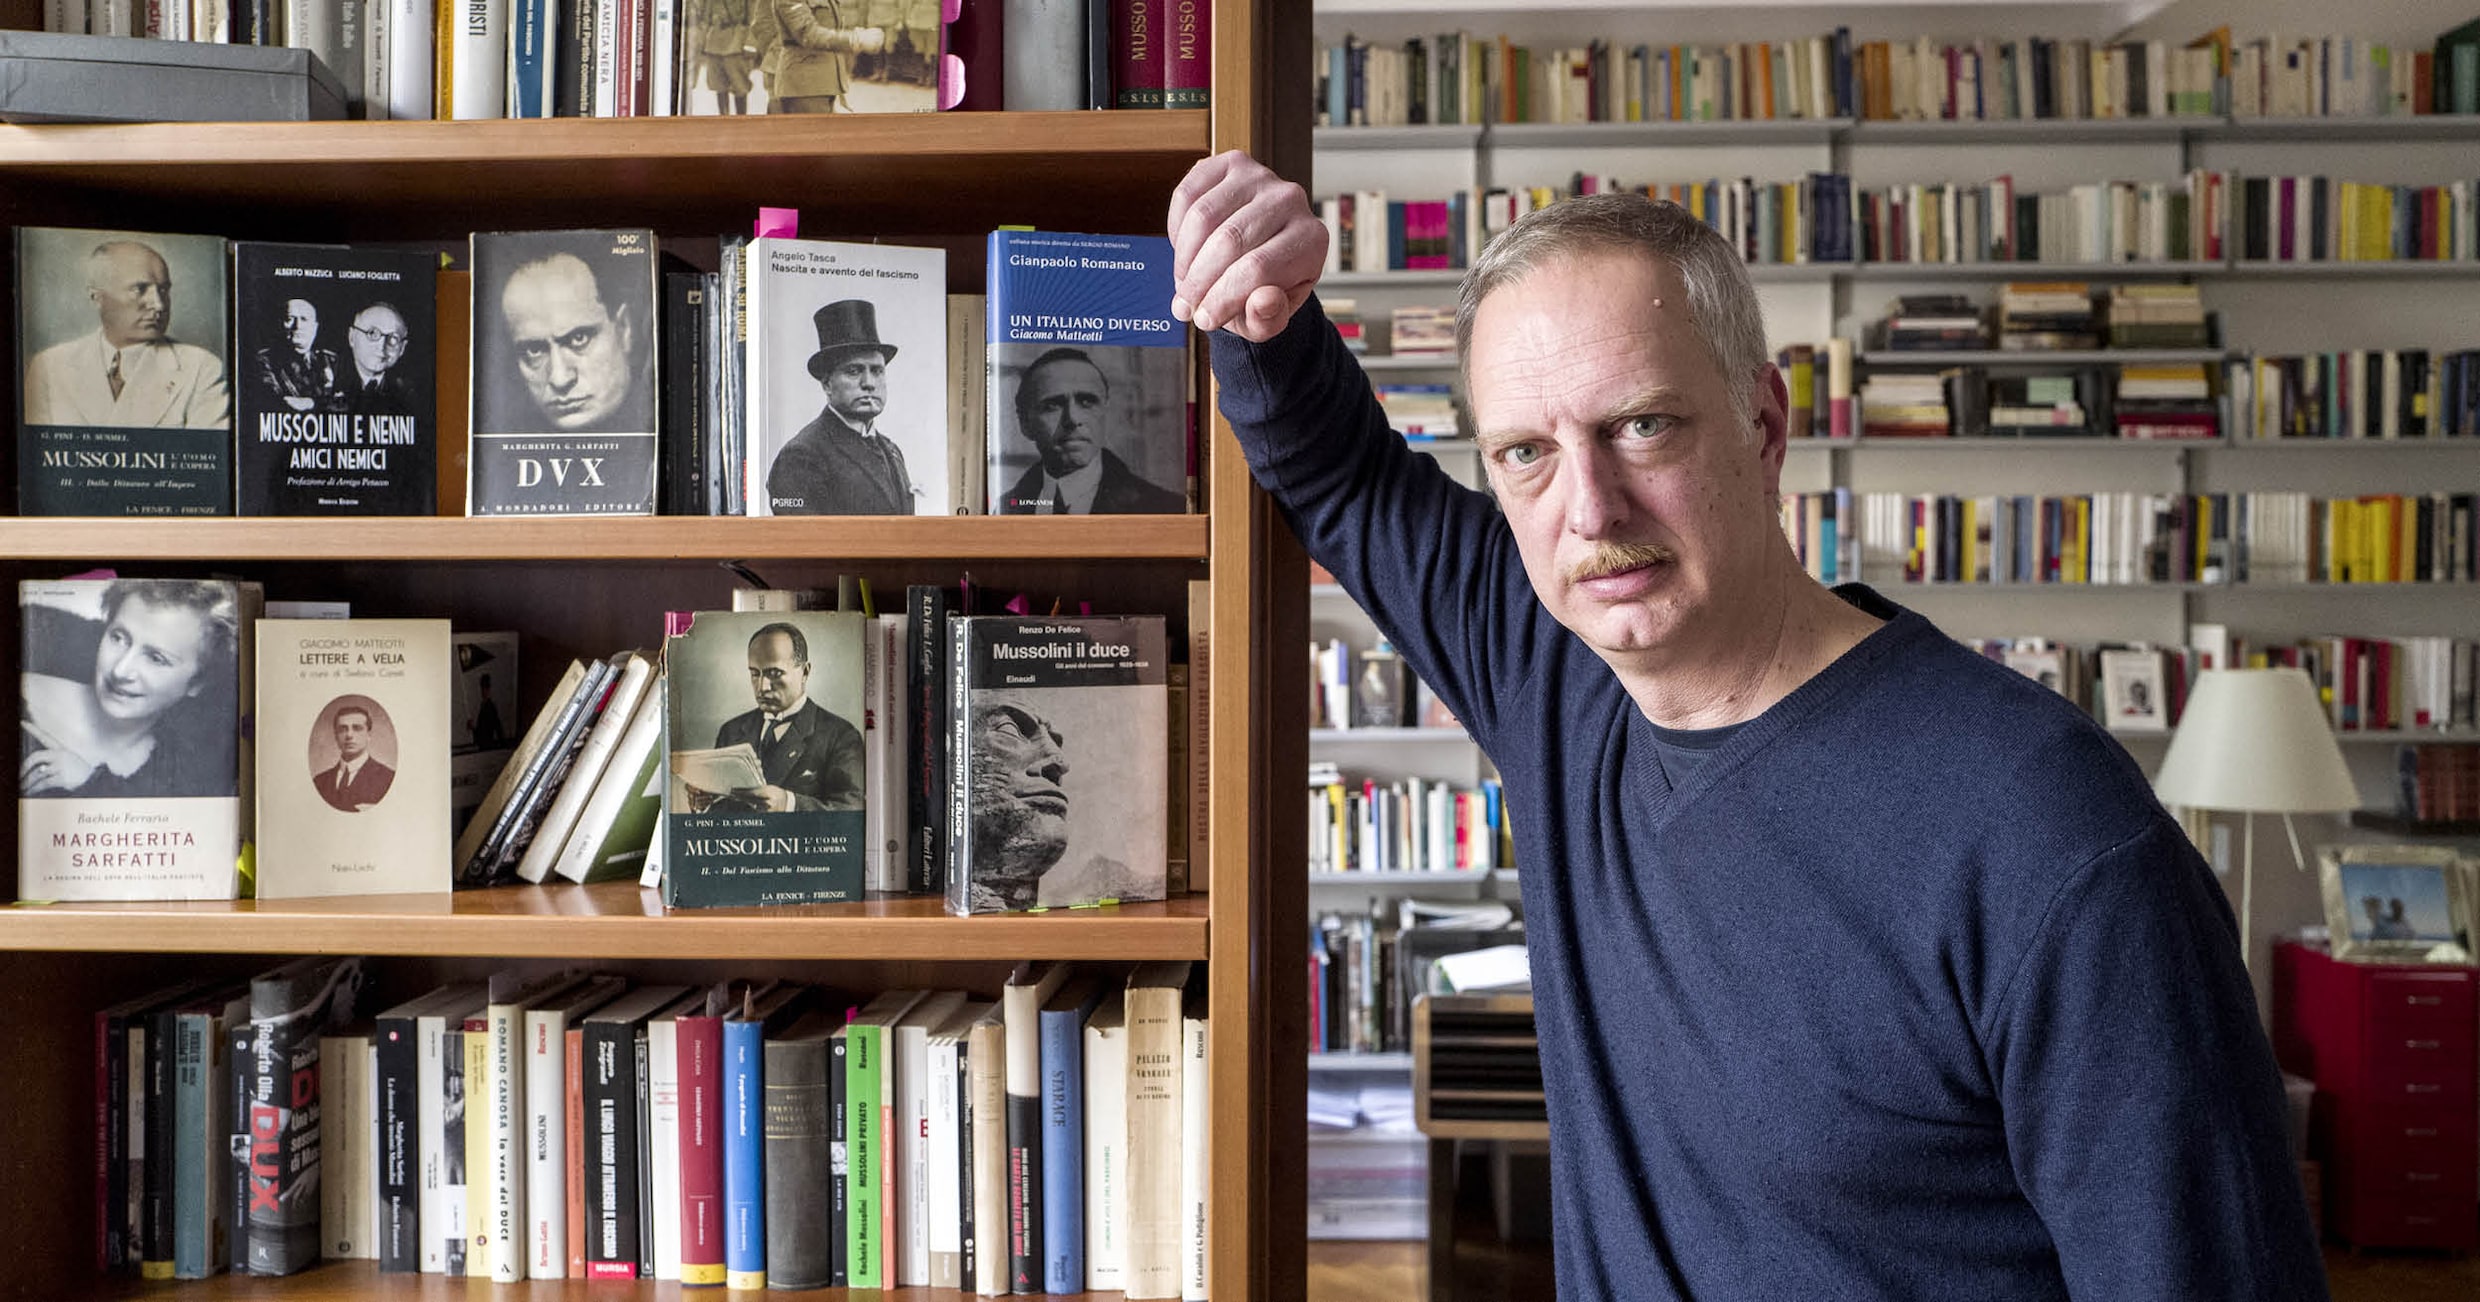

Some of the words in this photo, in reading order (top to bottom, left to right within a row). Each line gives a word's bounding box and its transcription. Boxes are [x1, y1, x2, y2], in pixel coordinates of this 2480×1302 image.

[580, 31, 592, 62] Partito
[601, 51, 610, 84] NERA
[581, 63, 592, 111] comunista
[771, 251, 806, 265] Angelo
[808, 252, 836, 263] Tasca
[1010, 254, 1078, 270] Gianpaolo
[1081, 257, 1145, 271] Romanato
[274, 268, 303, 277] ALBERTO
[304, 269, 333, 278] MAZZUCA
[338, 270, 366, 280] LUCIANO
[367, 271, 401, 281] FOGLIETTA
[771, 264, 808, 275] Nascita
[810, 267, 817, 275] e
[818, 267, 857, 277] avvento
[859, 267, 875, 278] del
[876, 269, 919, 280] fascismo
[1010, 315, 1032, 328] UN
[1036, 315, 1104, 330] ITALIANO
[1108, 318, 1171, 332] DIVERSO
[1010, 329, 1054, 340] Giacomo
[1056, 330, 1103, 342] Matteotti
[54, 432, 73, 441] PINI
[260, 412, 348, 444] MUSSOLINI
[354, 415, 364, 445] E
[369, 415, 415, 446] NENNI
[502, 443, 561, 451] MARGHERITA
[576, 443, 620, 451] SARFATTI
[42, 450, 166, 469] MUSSOLINI
[290, 448, 332, 470] AMICI
[337, 449, 387, 471] NEMICI
[517, 458, 605, 488] DVX
[286, 476, 326, 488] Prefazione
[327, 476, 336, 486] di
[496, 504, 571, 513] MONDADORI
[585, 503, 642, 512] EDITORE
[956, 624, 963, 641] R.
[1018, 626, 1043, 634] Renzo
[1045, 626, 1057, 634] De
[1058, 625, 1081, 634] Felice
[300, 639, 350, 649] GIACOMO
[355, 639, 405, 649] MATTEOTTI
[956, 642, 963, 662] De
[993, 642, 1072, 660] Mussolini
[1075, 642, 1087, 659] il
[1089, 642, 1130, 659] duce
[300, 653, 350, 665] LETTERE
[357, 653, 365, 665] A
[373, 653, 405, 665] VELIA
[1006, 675, 1036, 684] Einaudi
[955, 720, 964, 786] Mussolini
[77, 813, 120, 824] Rachele
[124, 813, 170, 823] Ferrario
[684, 819, 693, 827] G.
[696, 819, 713, 827] PINI
[722, 819, 732, 827] D.
[733, 819, 765, 827] SUSMEL
[955, 802, 964, 837] duce
[53, 833, 195, 847] MARGHERITA
[684, 837, 799, 857] MUSSOLINI
[72, 852, 176, 868] SARFATTI
[722, 866, 736, 875] Dal
[777, 866, 792, 874] alla
[796, 865, 830, 874] Dittatura
[761, 892, 774, 900] LA
[776, 892, 805, 900] FENICE
[813, 891, 847, 899] FIRENZE
[257, 1023, 273, 1073] Roberto
[498, 1017, 508, 1073] ROMANO
[1195, 1031, 1204, 1059] Rusconi
[1136, 1054, 1171, 1065] PALAZZO
[257, 1076, 273, 1101] Olla
[498, 1078, 508, 1129] CANOSA
[1051, 1070, 1066, 1127] STARACE
[858, 1102, 868, 1139] PRIVATO
[538, 1114, 547, 1162] MUSSOLINI
[250, 1106, 279, 1212] DUX
[858, 1141, 868, 1188] MUSSOLINI
[499, 1187, 508, 1204] del
[500, 1210, 508, 1241] DUCE
[595, 1263, 629, 1274] MURSIA
